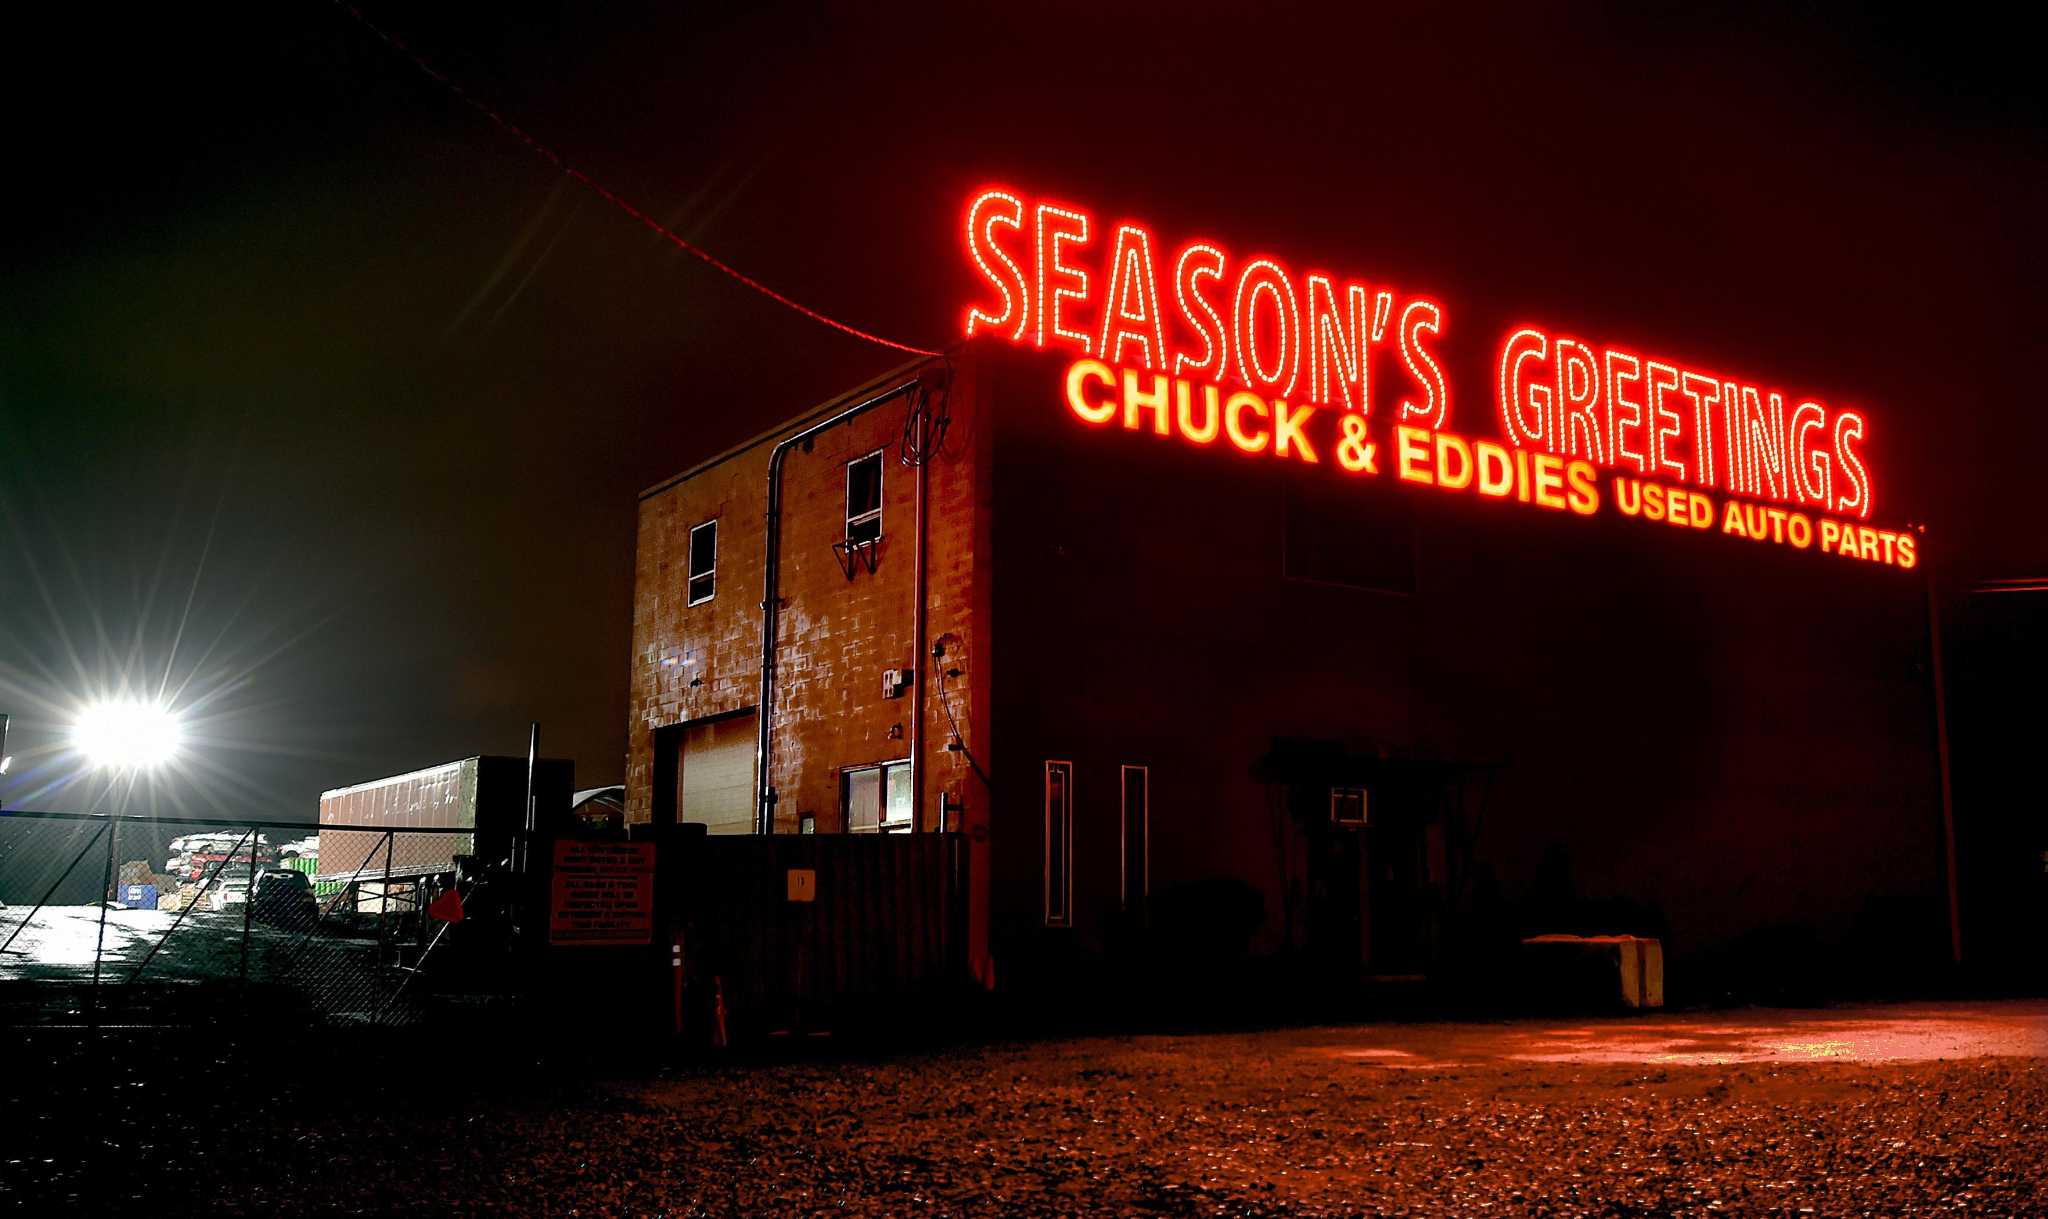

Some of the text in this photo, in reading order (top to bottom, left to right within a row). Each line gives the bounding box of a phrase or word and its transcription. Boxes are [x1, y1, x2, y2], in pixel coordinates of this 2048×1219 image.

[968, 191, 1870, 518] SEASON'S GREETINGS
[1065, 358, 1917, 569] CHUCK & EDDIES USED AUTO PARTS
